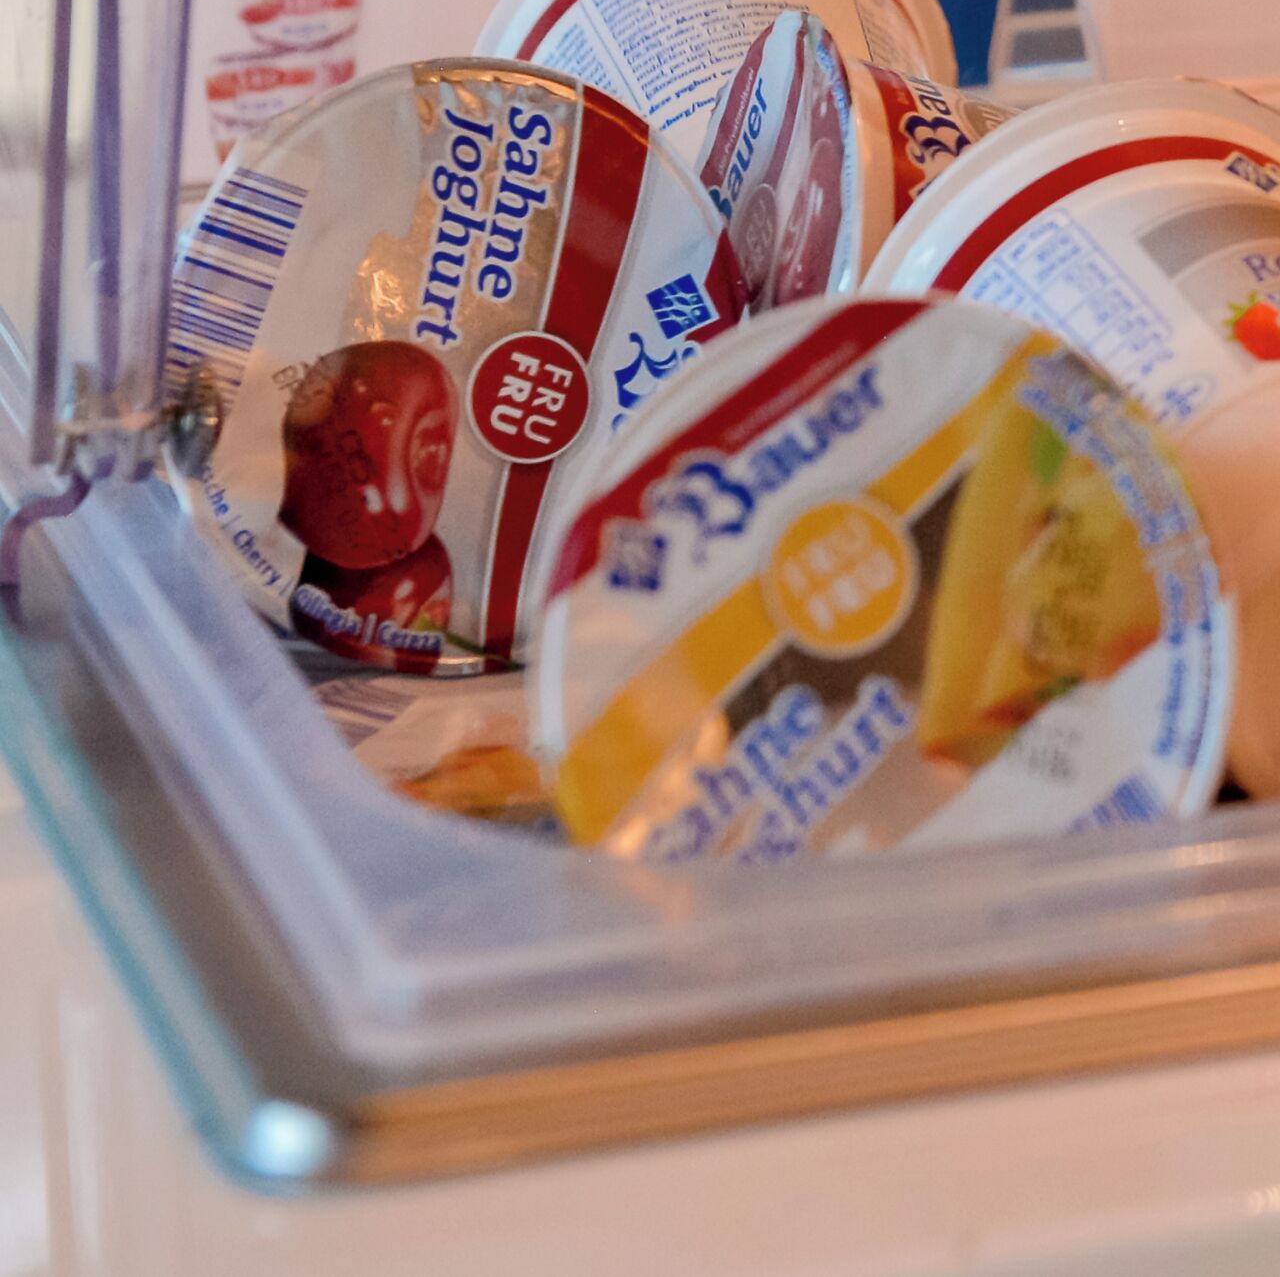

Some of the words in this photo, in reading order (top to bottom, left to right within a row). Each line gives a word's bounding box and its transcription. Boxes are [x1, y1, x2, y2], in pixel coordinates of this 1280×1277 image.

[415, 107, 495, 347] Joghurt
[477, 104, 553, 301] Sahne
[489, 351, 541, 436] FRU
[522, 362, 574, 446] FRU
[232, 527, 283, 587] Cherry
[650, 692, 815, 864] ahne
[738, 686, 907, 865] ghurt
